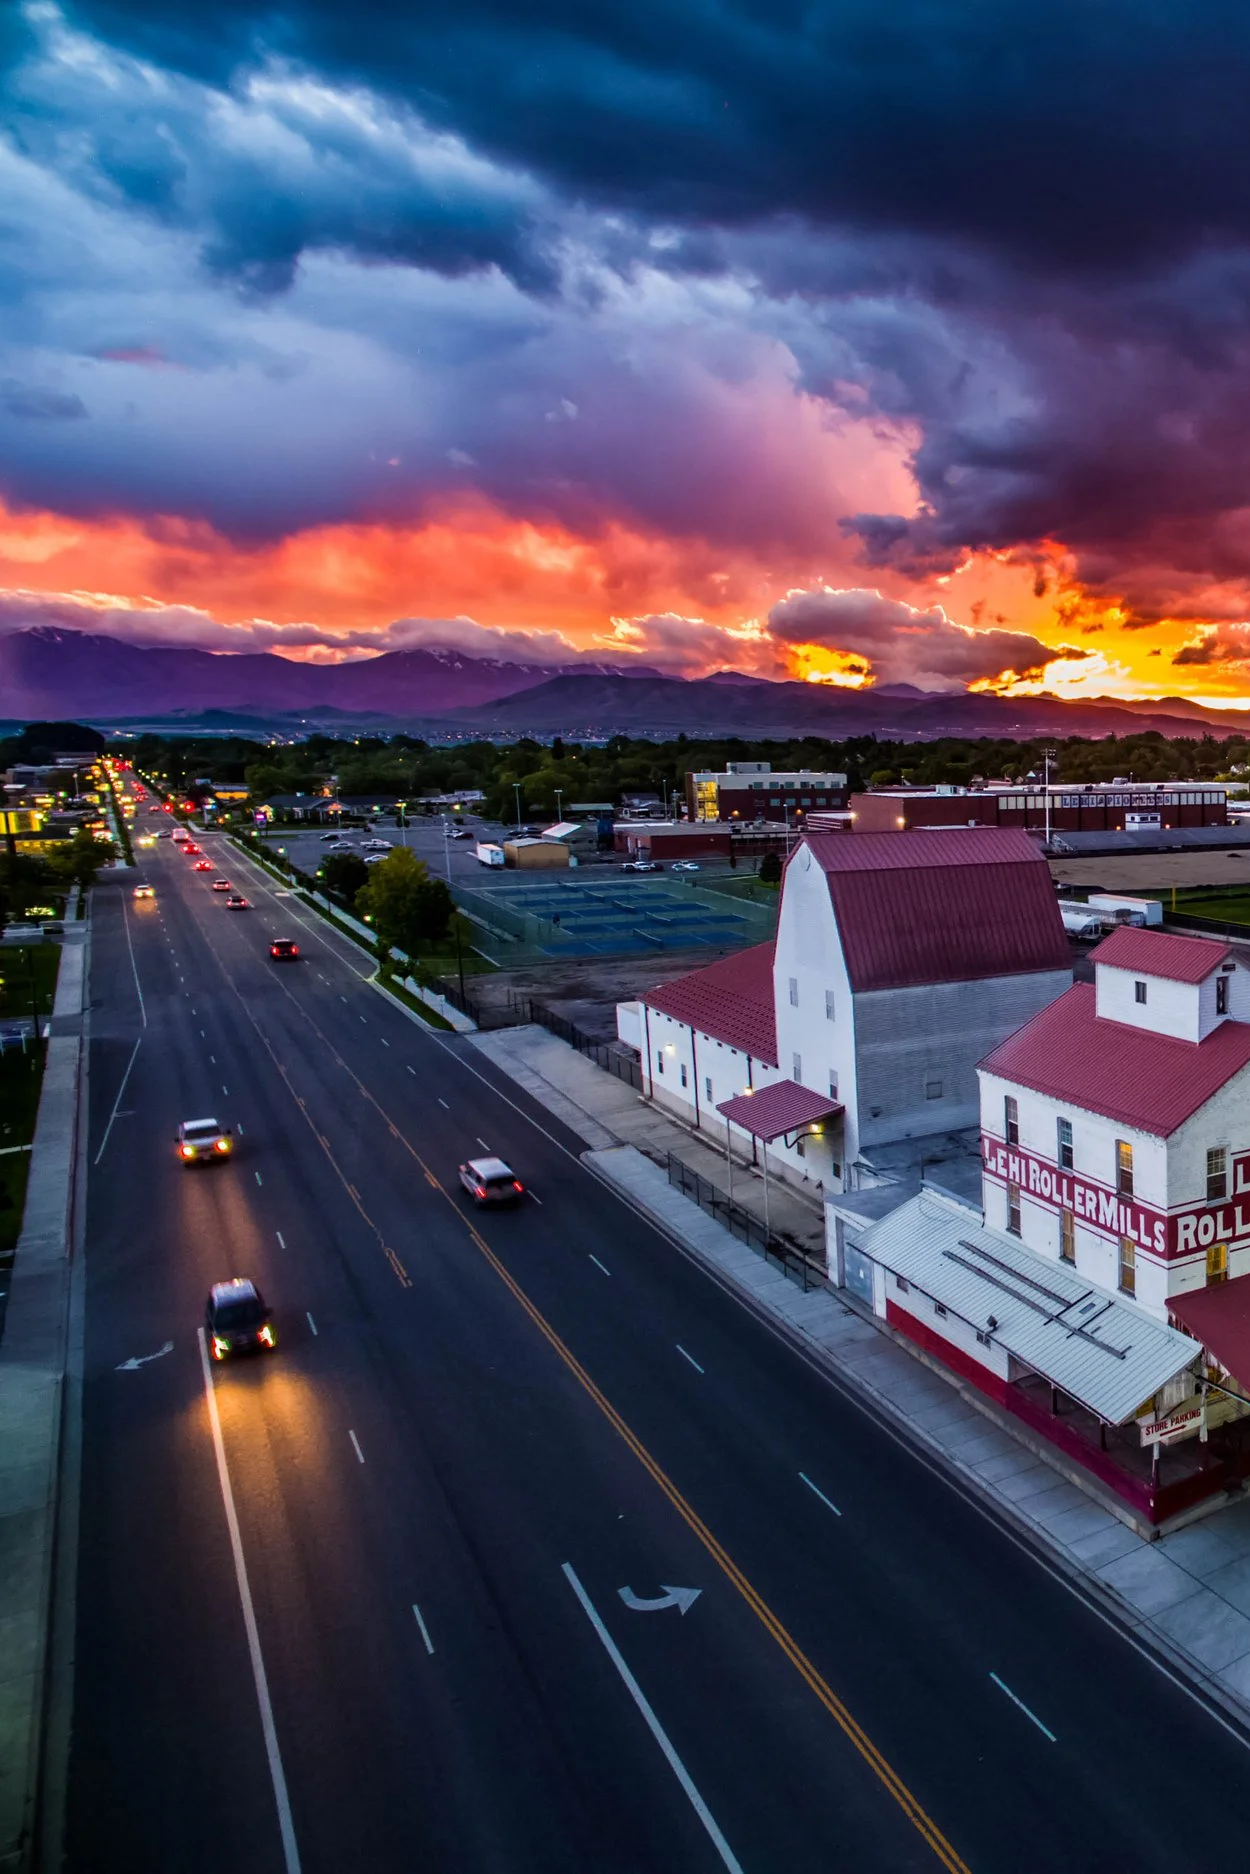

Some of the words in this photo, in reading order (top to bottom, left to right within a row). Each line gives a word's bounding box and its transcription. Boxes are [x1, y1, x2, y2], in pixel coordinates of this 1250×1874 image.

[1063, 795, 1096, 807] LEHI
[983, 1138, 1026, 1187] LEHI
[1145, 1420, 1169, 1436] STORE
[1170, 1408, 1201, 1427] PARKING
